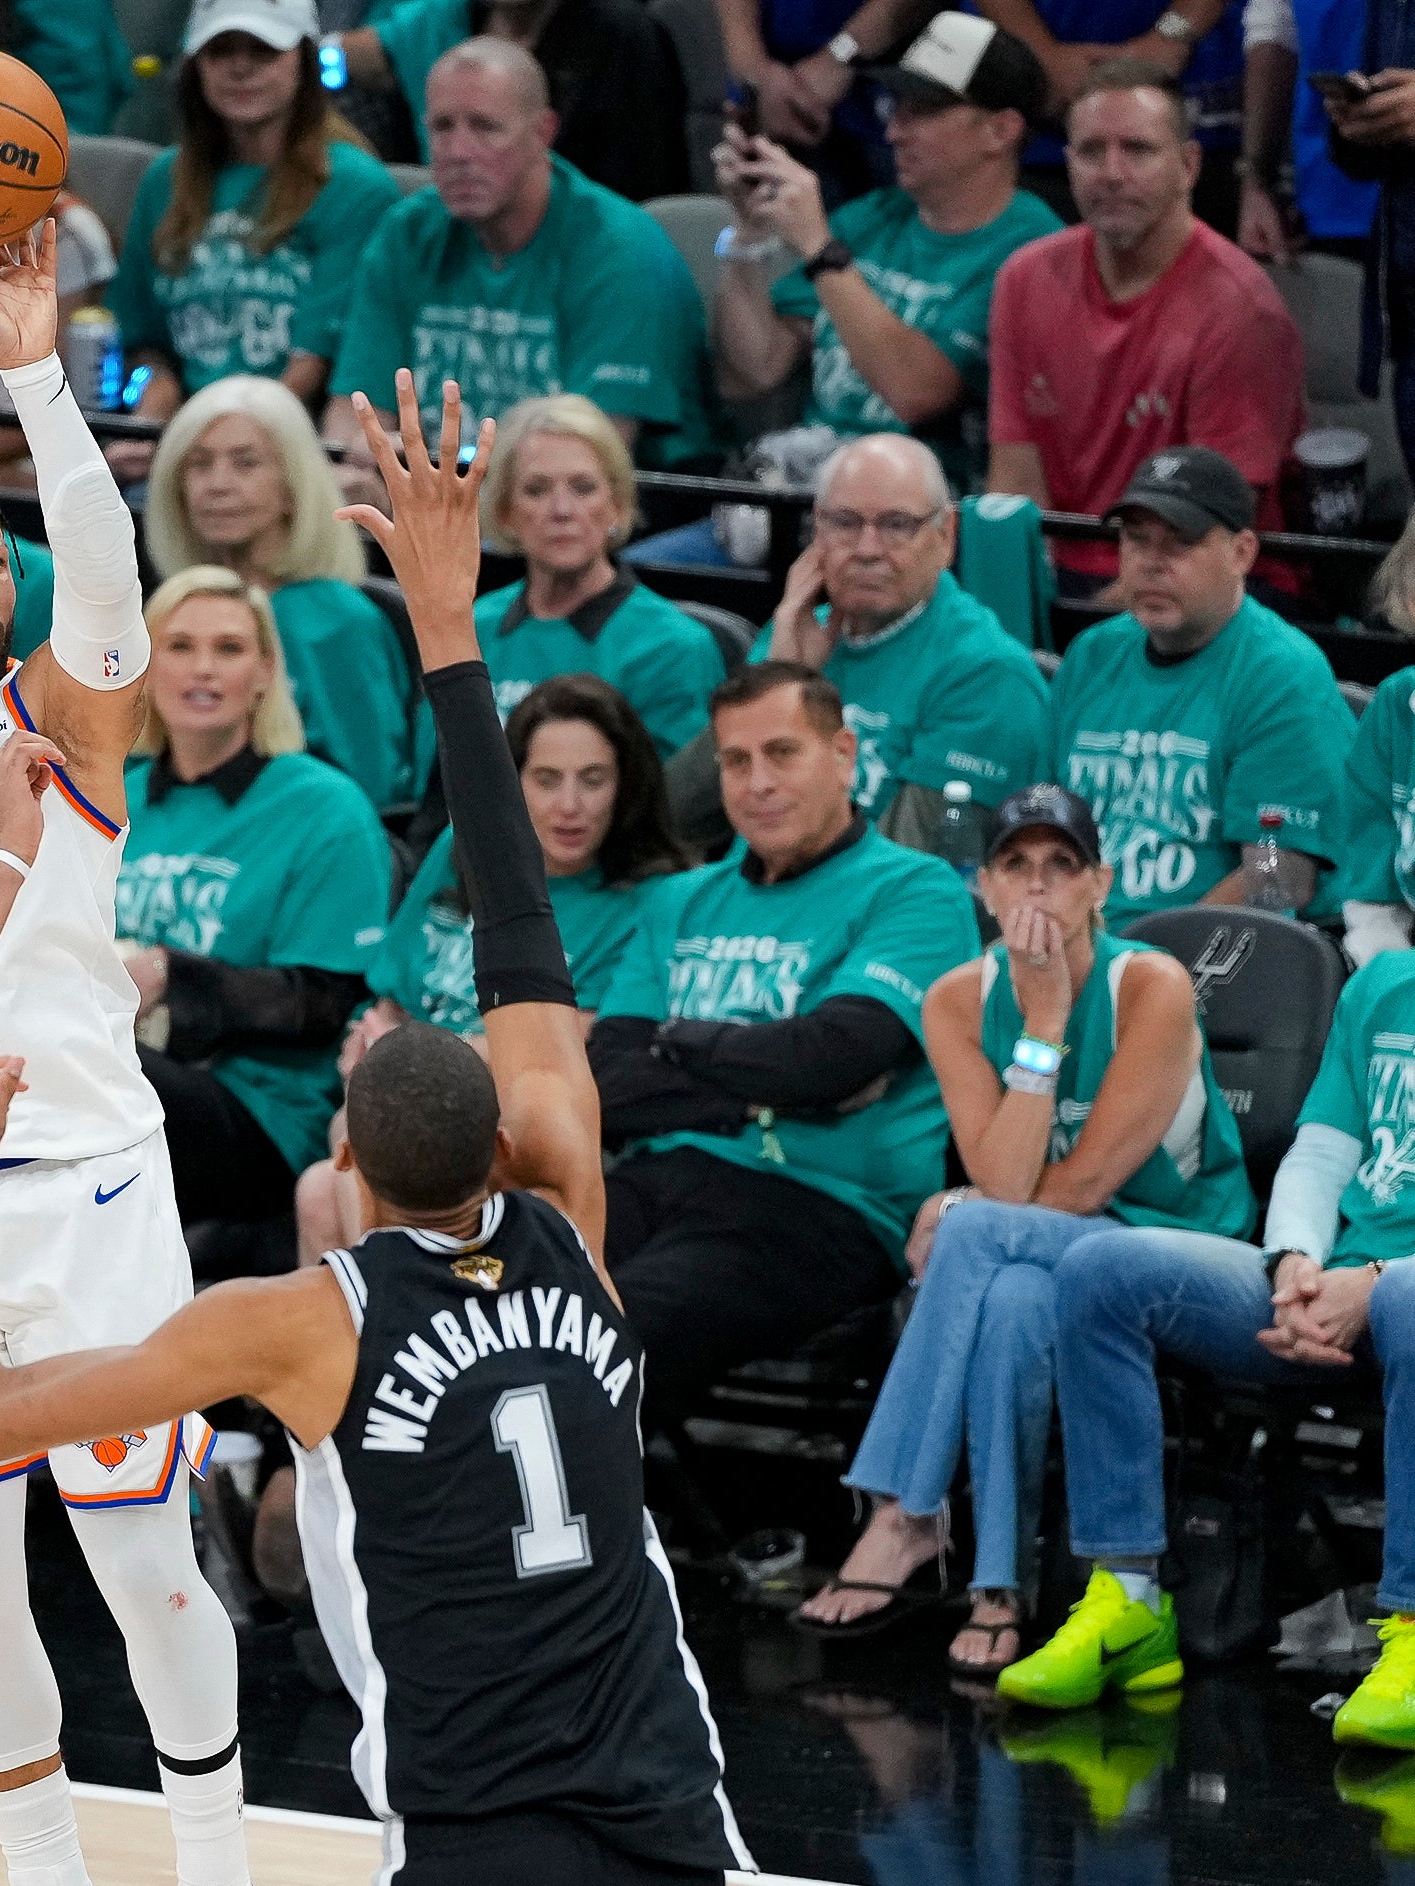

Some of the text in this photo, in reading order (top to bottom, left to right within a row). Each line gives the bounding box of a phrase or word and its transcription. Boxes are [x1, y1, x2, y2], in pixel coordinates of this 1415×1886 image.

[1121, 828, 1197, 900] GO
[361, 1286, 634, 1453] WEMBANYAMA
[489, 1382, 594, 1580] 1
